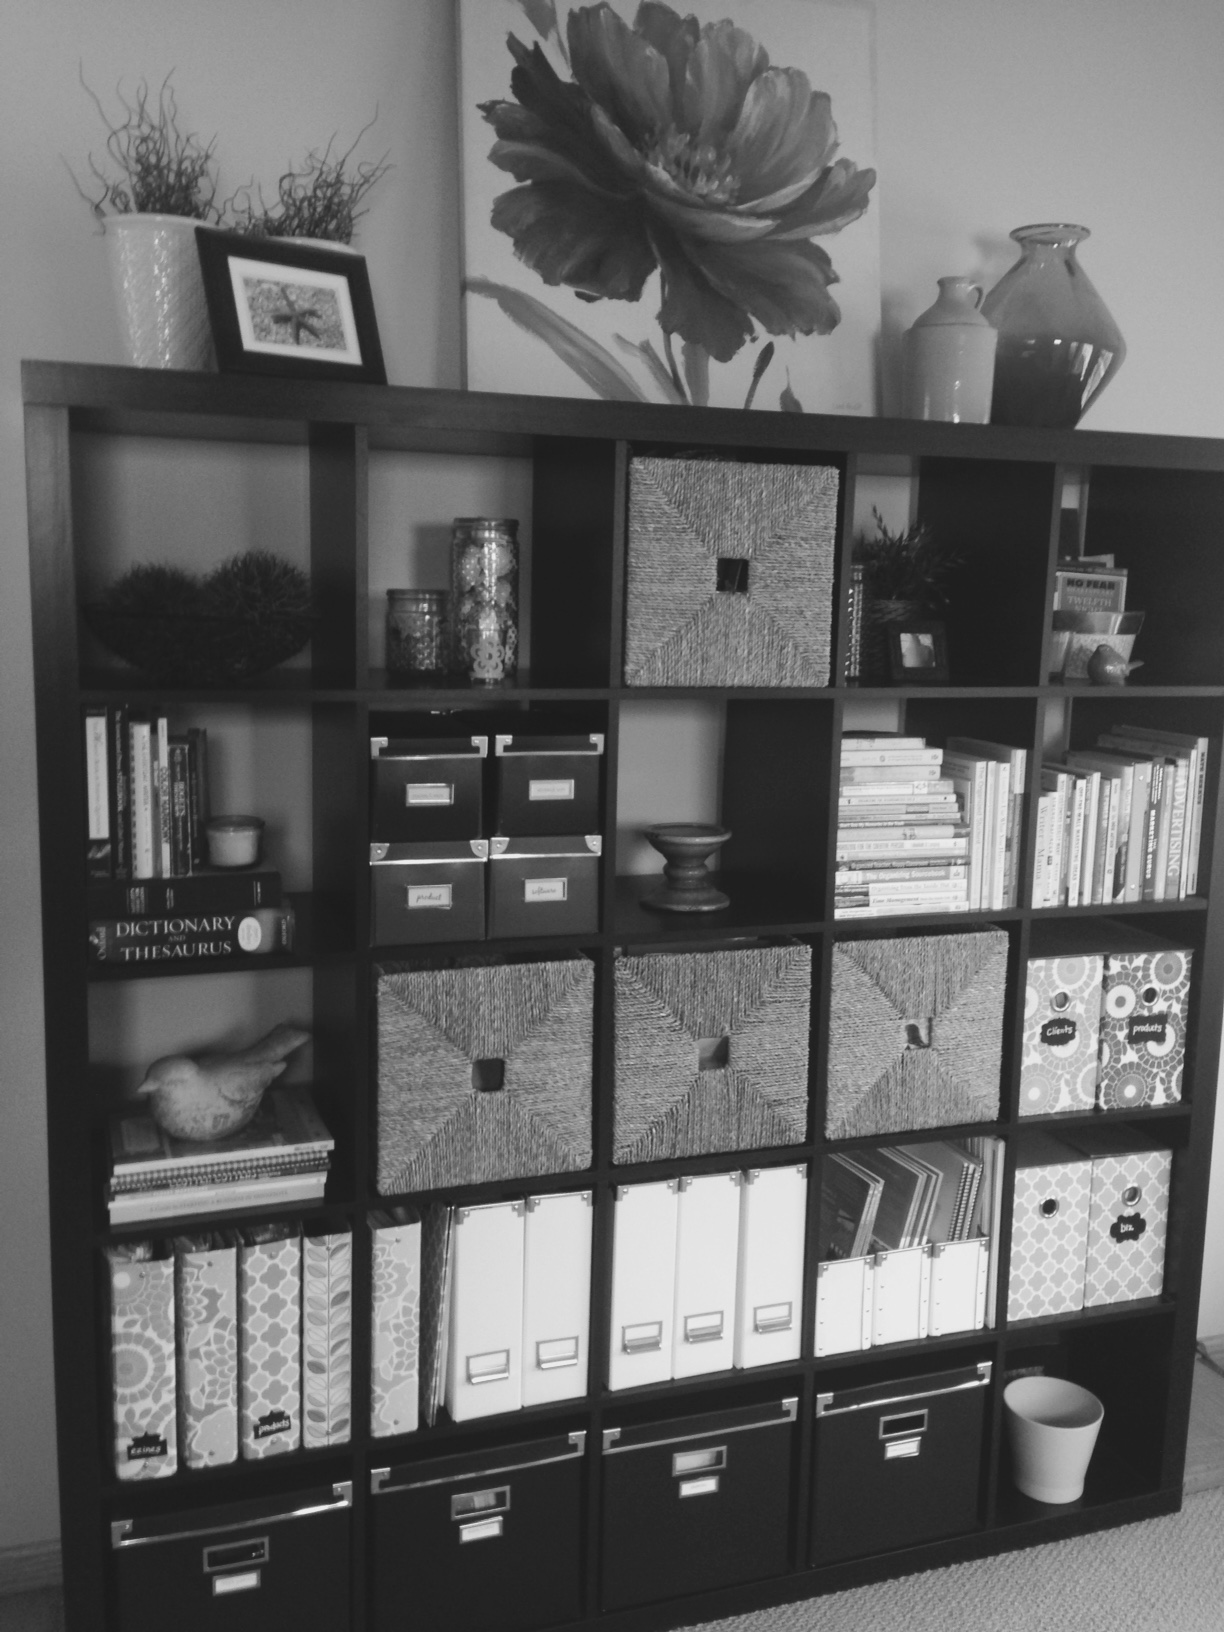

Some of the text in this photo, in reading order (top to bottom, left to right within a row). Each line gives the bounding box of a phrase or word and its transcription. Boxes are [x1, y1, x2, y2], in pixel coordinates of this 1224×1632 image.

[1066, 578, 1116, 590] NO FEAR
[975, 780, 984, 816] Organized
[1147, 810, 1156, 853] MARKETING
[1167, 777, 1186, 877] ADVERTISING
[1035, 806, 1048, 880] Writer Mama
[878, 871, 910, 880] Organizing
[911, 870, 946, 878] Sourcebook
[532, 886, 557, 896] software
[416, 892, 442, 902] product
[886, 896, 919, 904] Management
[116, 916, 236, 938] DICTIONARY
[168, 934, 186, 942] AND
[120, 941, 232, 961] THESAURUS
[1132, 1022, 1162, 1033] products
[1120, 1223, 1134, 1233] biz
